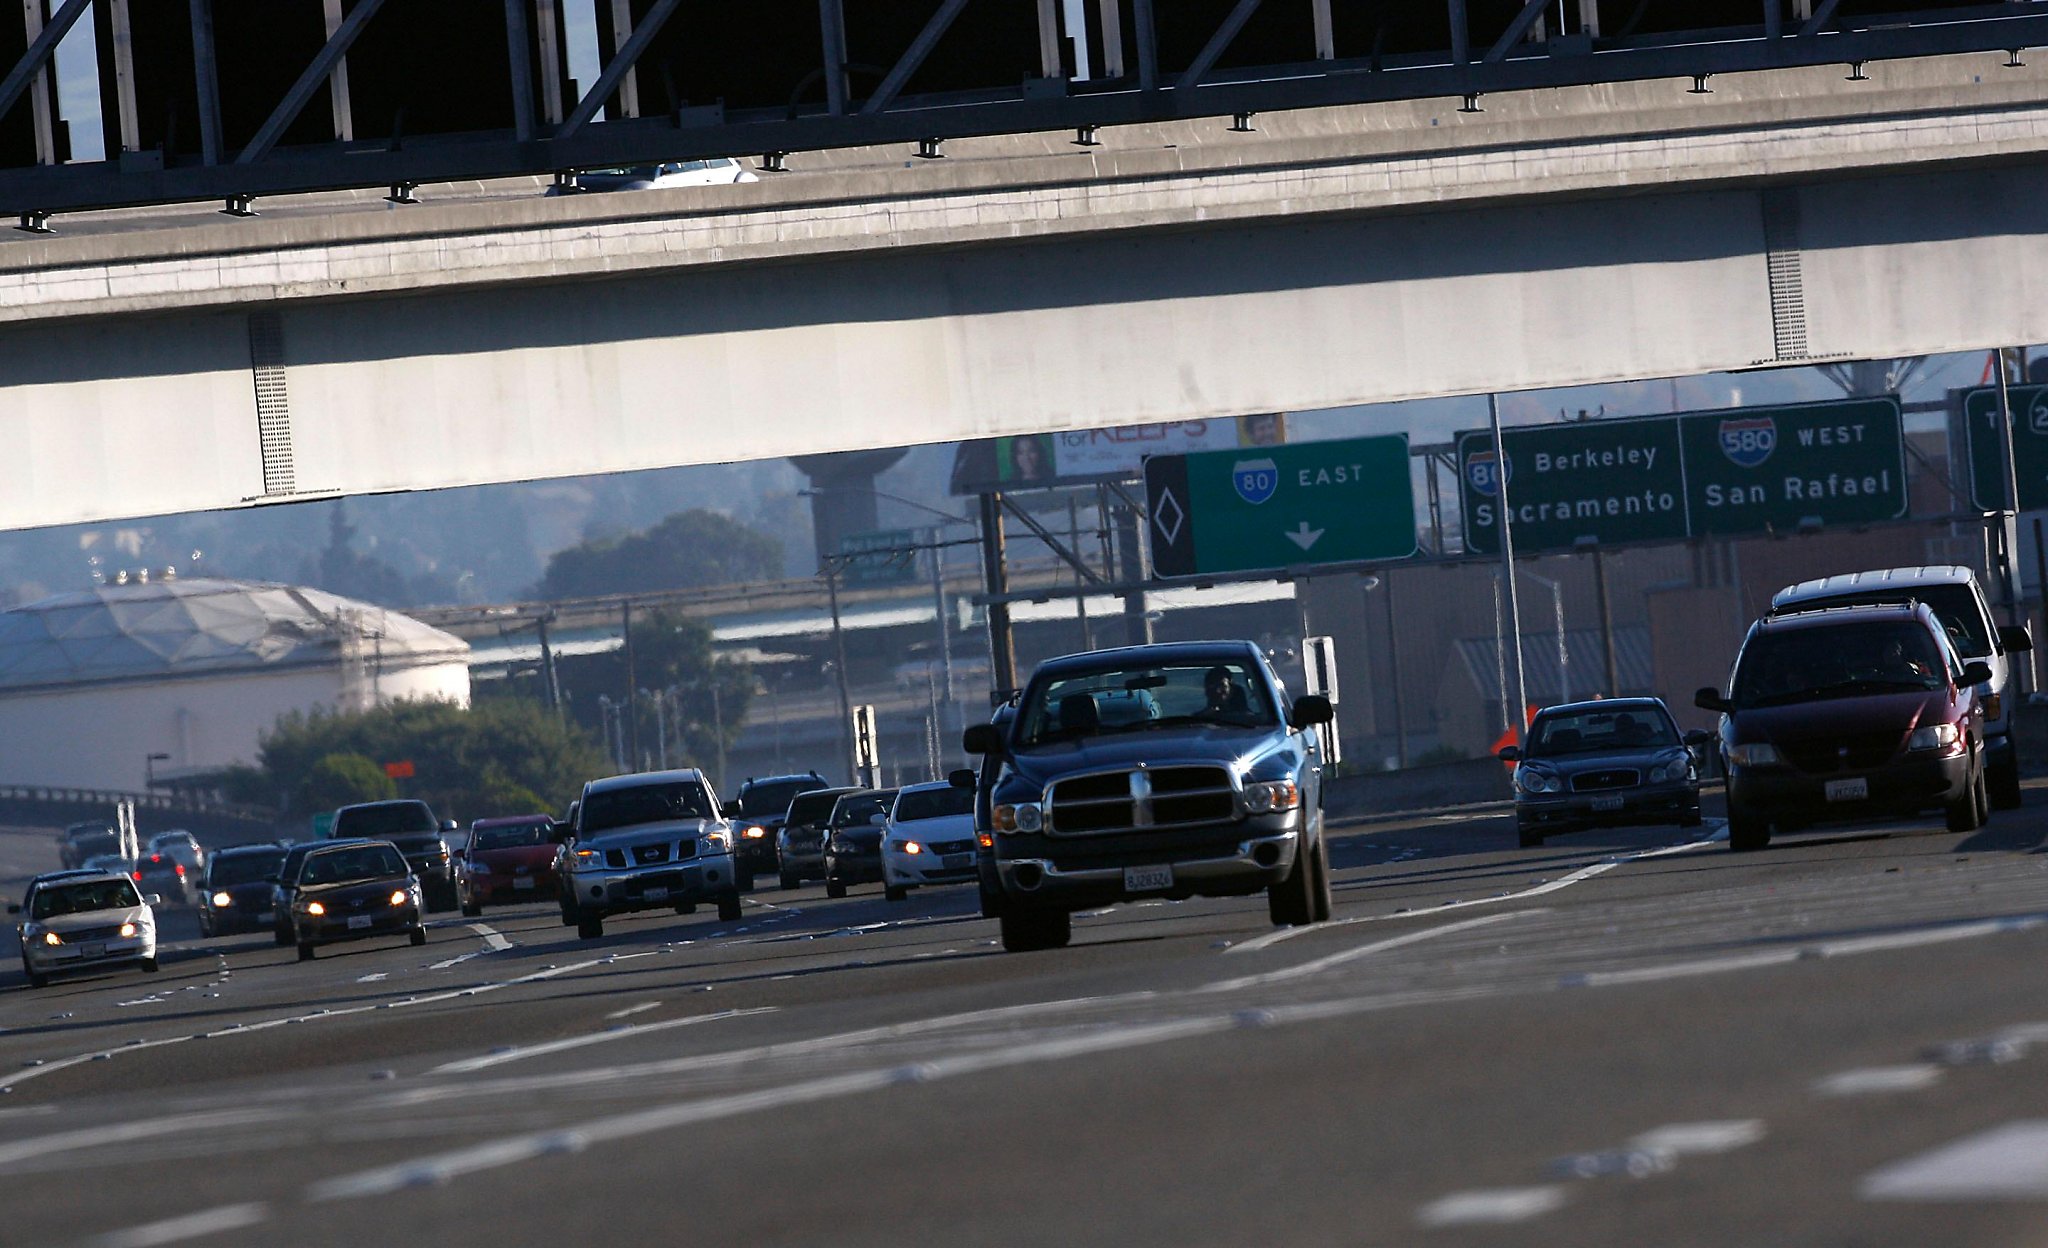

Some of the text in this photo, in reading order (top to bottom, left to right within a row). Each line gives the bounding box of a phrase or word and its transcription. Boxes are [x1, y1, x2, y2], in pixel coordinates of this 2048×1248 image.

[1724, 424, 1865, 452] 580 WEST
[1535, 445, 1657, 472] Berkeley
[1242, 464, 1362, 491] 80 EAST
[1705, 469, 1890, 506] San Rafael
